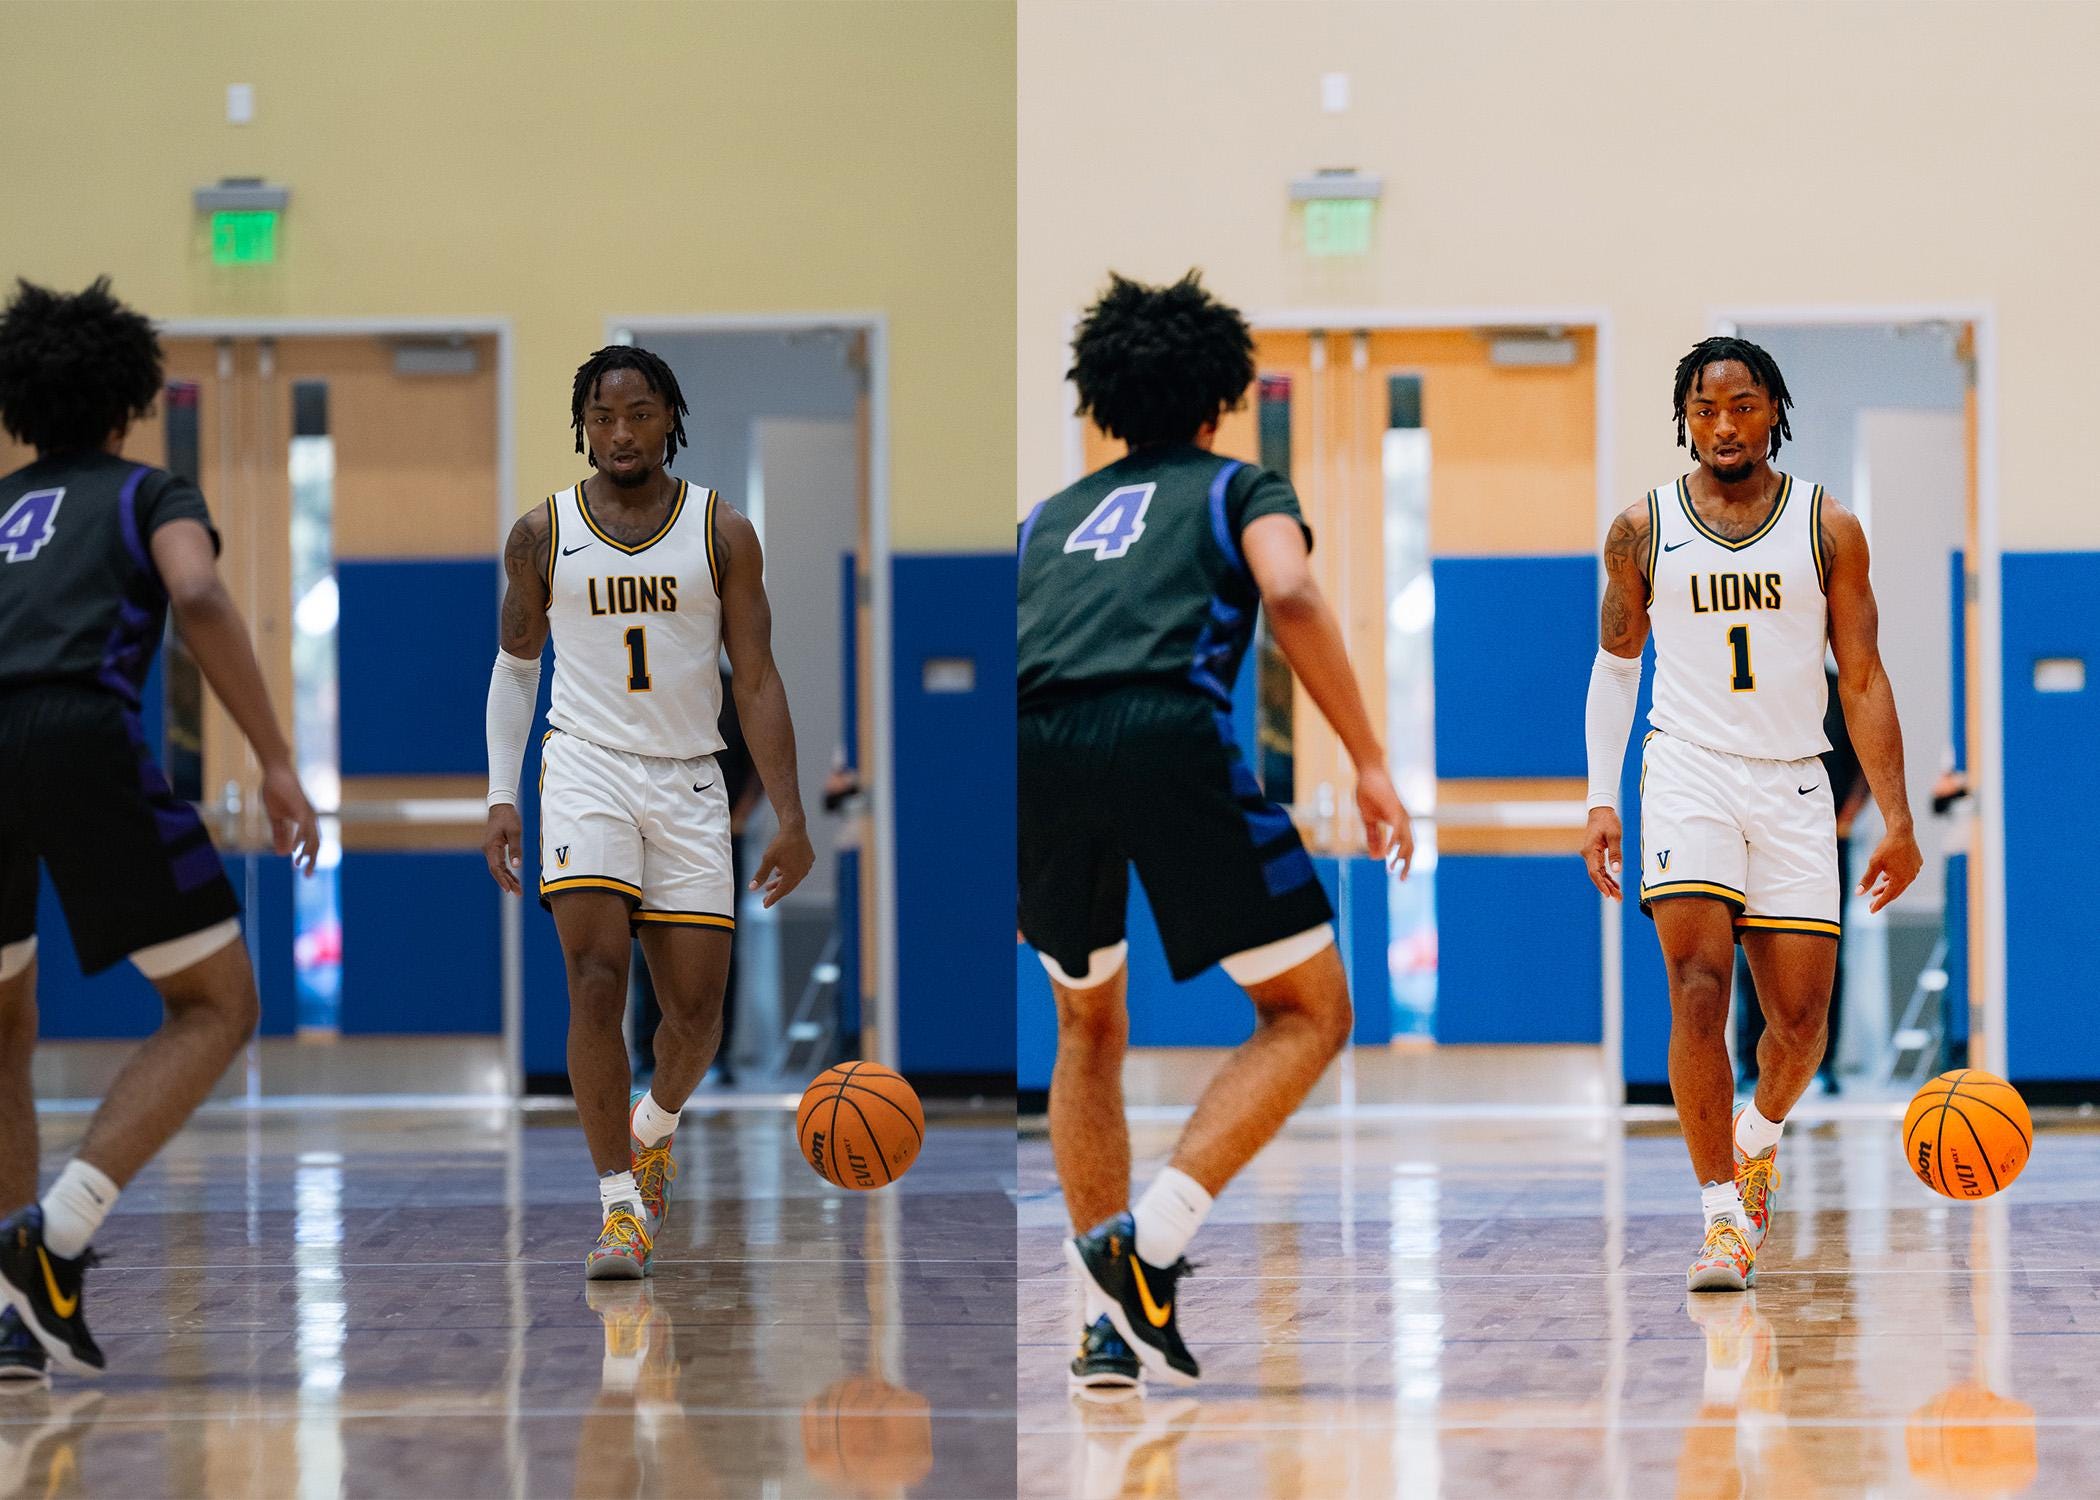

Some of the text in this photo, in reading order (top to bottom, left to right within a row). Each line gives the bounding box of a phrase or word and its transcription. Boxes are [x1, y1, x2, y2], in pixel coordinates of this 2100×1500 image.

[0, 486, 67, 564] 4
[1063, 482, 1157, 561] 4
[588, 575, 678, 616] LIONS
[1690, 571, 1782, 614] LIONS
[623, 625, 652, 693] 1
[1726, 623, 1756, 693] 1
